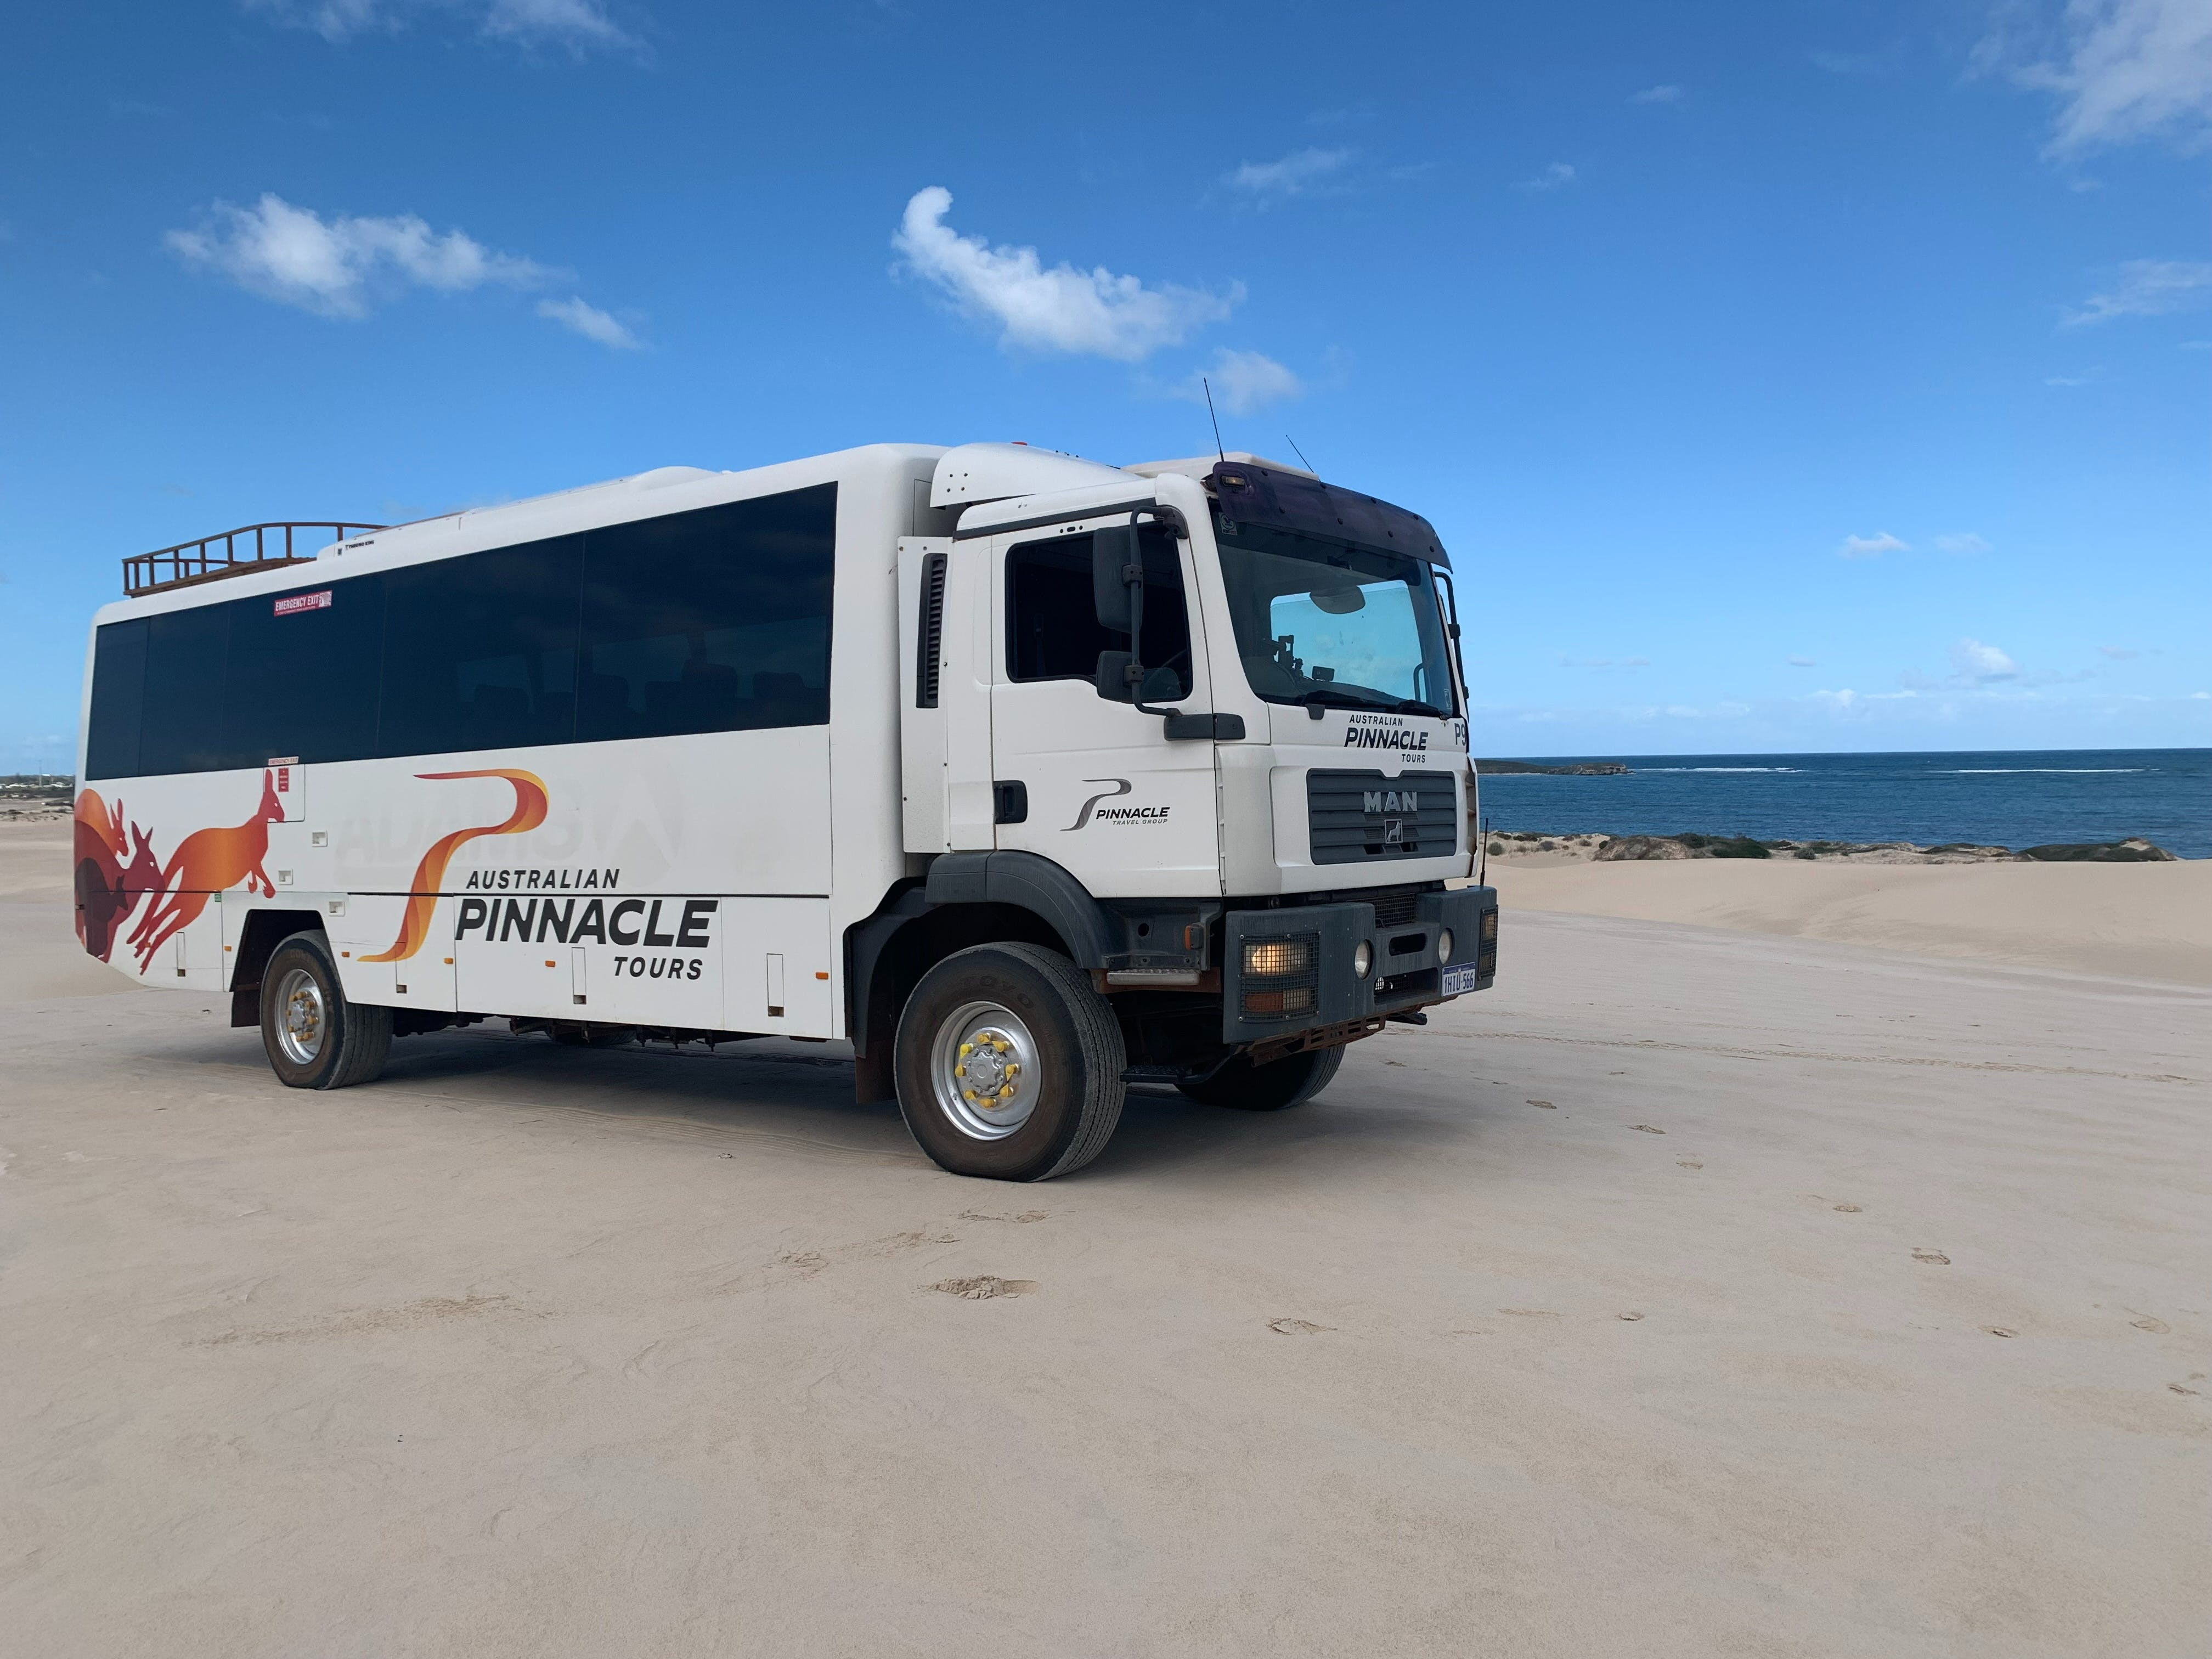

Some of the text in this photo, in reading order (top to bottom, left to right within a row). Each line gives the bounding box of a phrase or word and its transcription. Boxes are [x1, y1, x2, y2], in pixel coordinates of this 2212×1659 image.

[275, 597, 307, 611] EMERGENCY
[307, 594, 319, 605] EXIT
[1349, 714, 1403, 726] AUSTRALIAN
[1344, 727, 1429, 751] PINNACLE
[1402, 754, 1425, 763] TOURS
[1364, 791, 1418, 812] MAN
[1096, 807, 1170, 820] PINNACLE
[466, 868, 620, 889] AUSTRALIAN
[455, 899, 718, 948] PINNACLE
[614, 956, 703, 980] TOURS
